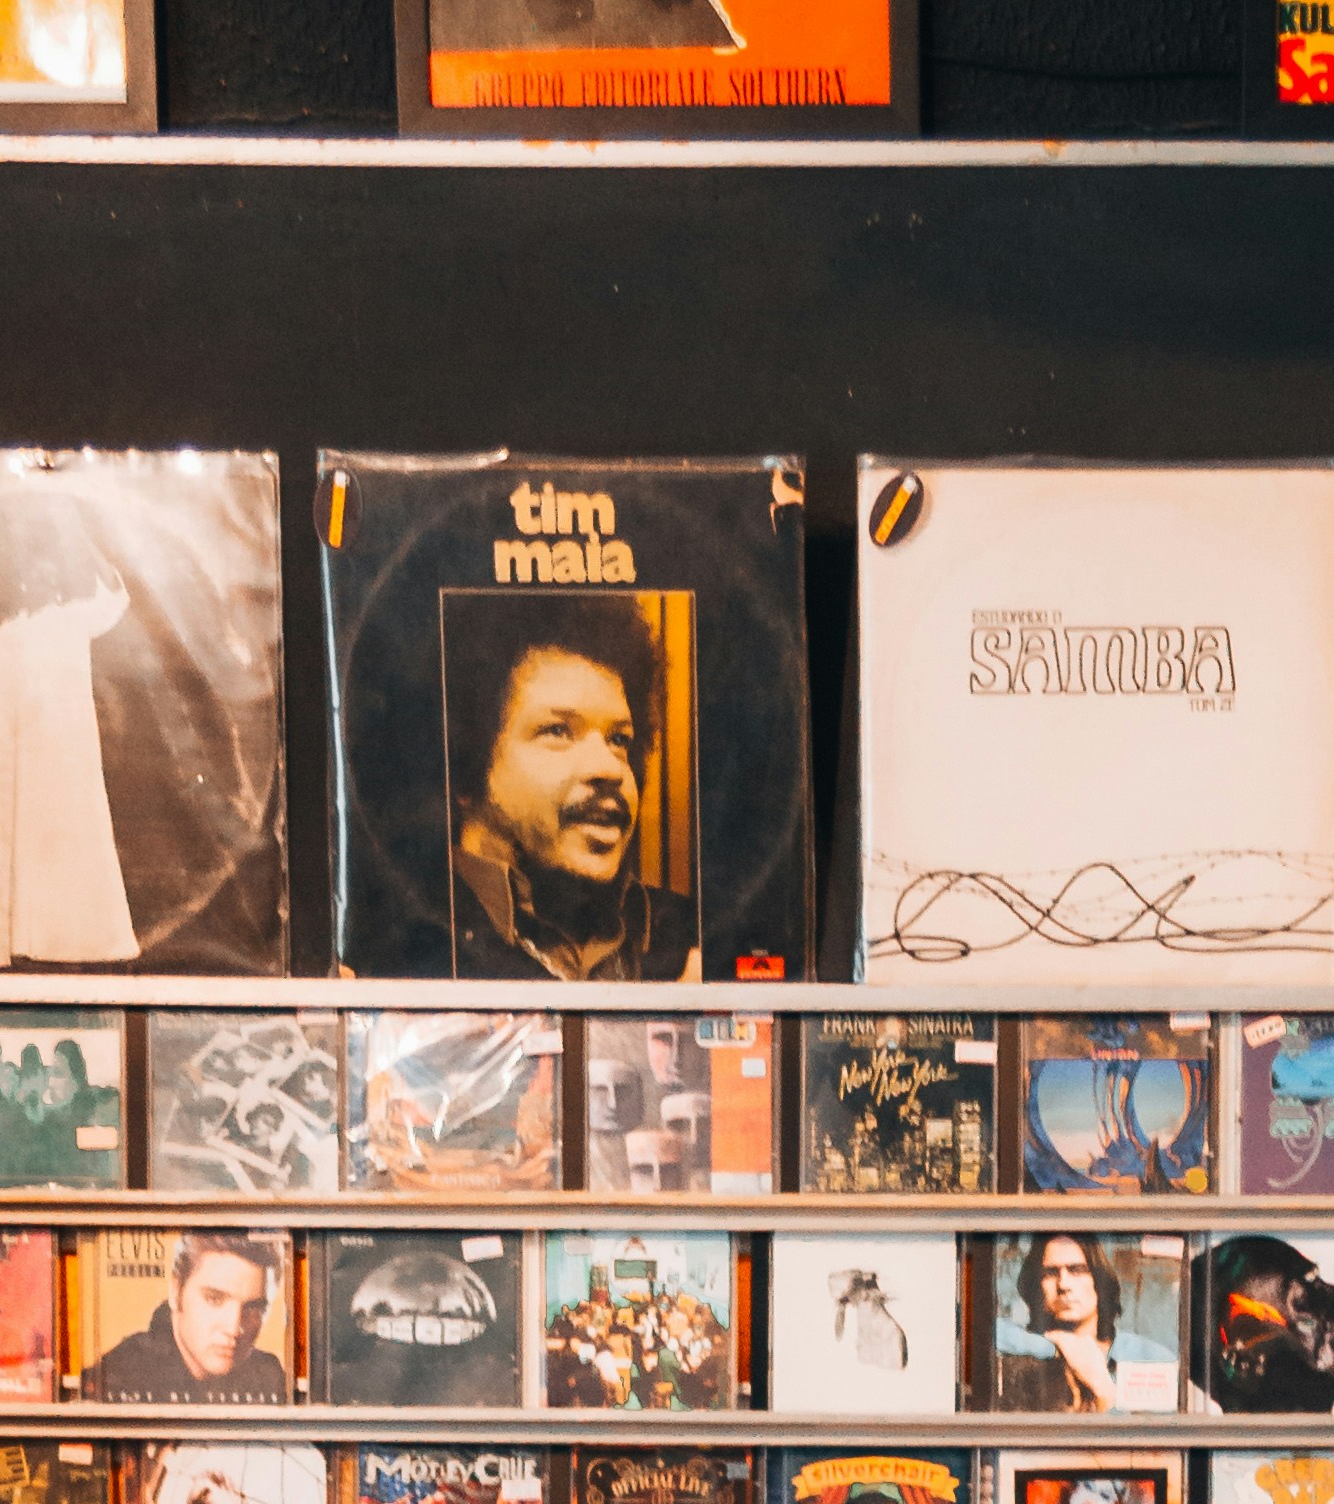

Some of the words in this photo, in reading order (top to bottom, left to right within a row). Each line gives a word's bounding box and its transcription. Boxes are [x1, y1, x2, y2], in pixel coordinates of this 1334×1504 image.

[510, 482, 615, 535] tim
[493, 536, 636, 583] maia
[970, 626, 1236, 695] SAMBA
[823, 1013, 876, 1035] FRANK
[907, 1013, 974, 1036] SINATRA
